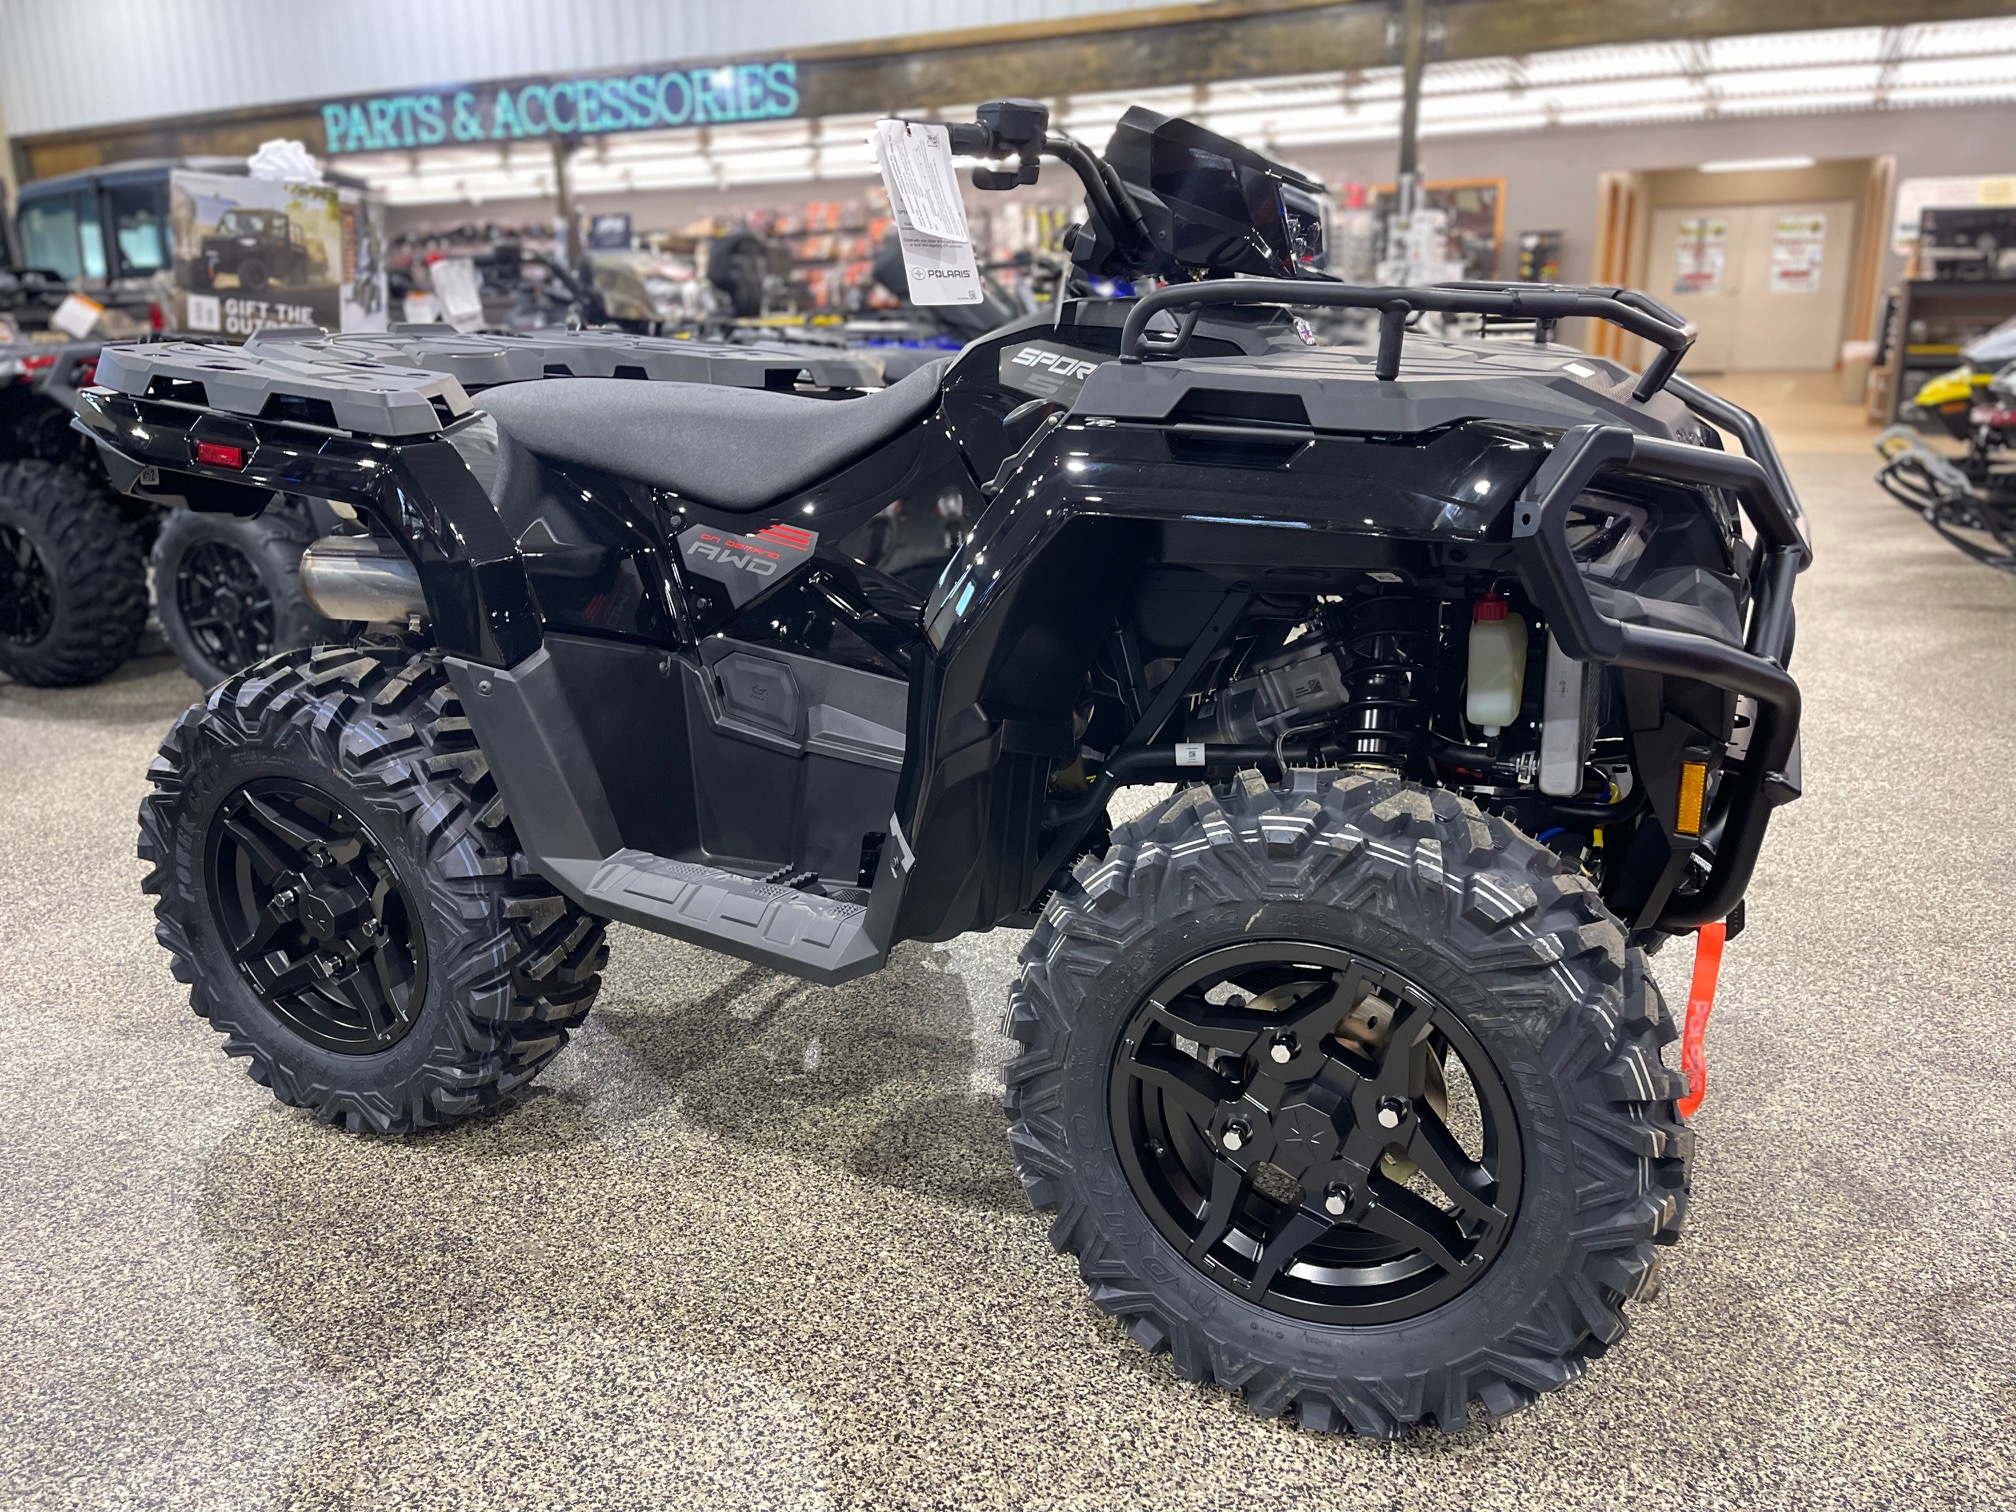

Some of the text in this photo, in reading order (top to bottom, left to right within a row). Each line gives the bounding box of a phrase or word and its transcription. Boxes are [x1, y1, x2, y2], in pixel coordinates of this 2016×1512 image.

[321, 61, 798, 154] PARTS & ACCESSORIES
[927, 269, 971, 279] POLARIS
[225, 298, 314, 325] GIFT THE
[1011, 347, 1099, 380] SPOR
[686, 541, 778, 576] AWD
